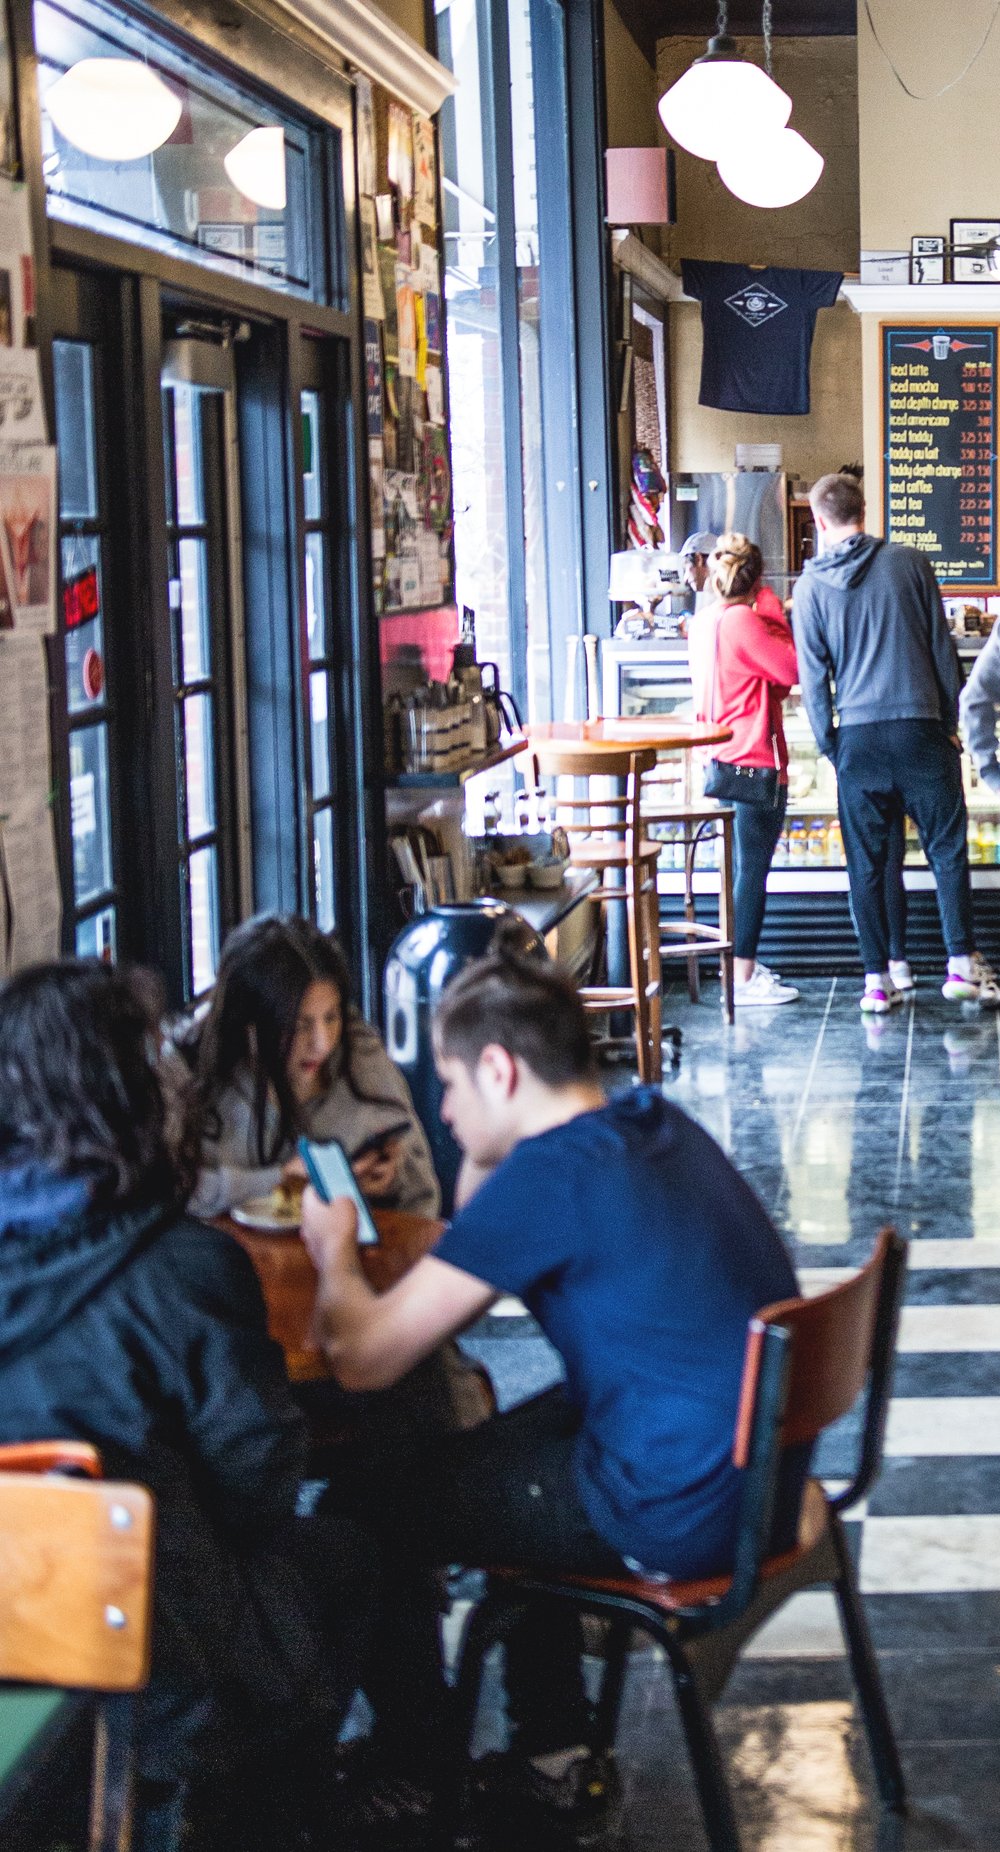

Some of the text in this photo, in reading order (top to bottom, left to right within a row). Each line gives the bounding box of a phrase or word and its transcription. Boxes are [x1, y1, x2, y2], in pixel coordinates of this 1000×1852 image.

[890, 363, 929, 377] iced latte
[890, 379, 939, 393] iced mocha
[890, 396, 959, 412] iced depth charge
[890, 413, 950, 426] iced americano
[890, 430, 933, 446] iced toddy
[889, 447, 913, 462] toddy
[925, 447, 939, 460] lait
[889, 463, 961, 479] toddy depth charge
[889, 480, 905, 493] iced
[907, 480, 933, 493] coffee
[890, 496, 907, 510] iced
[908, 497, 922, 510] tea
[890, 514, 926, 527] iced chai
[917, 530, 937, 542] soda
